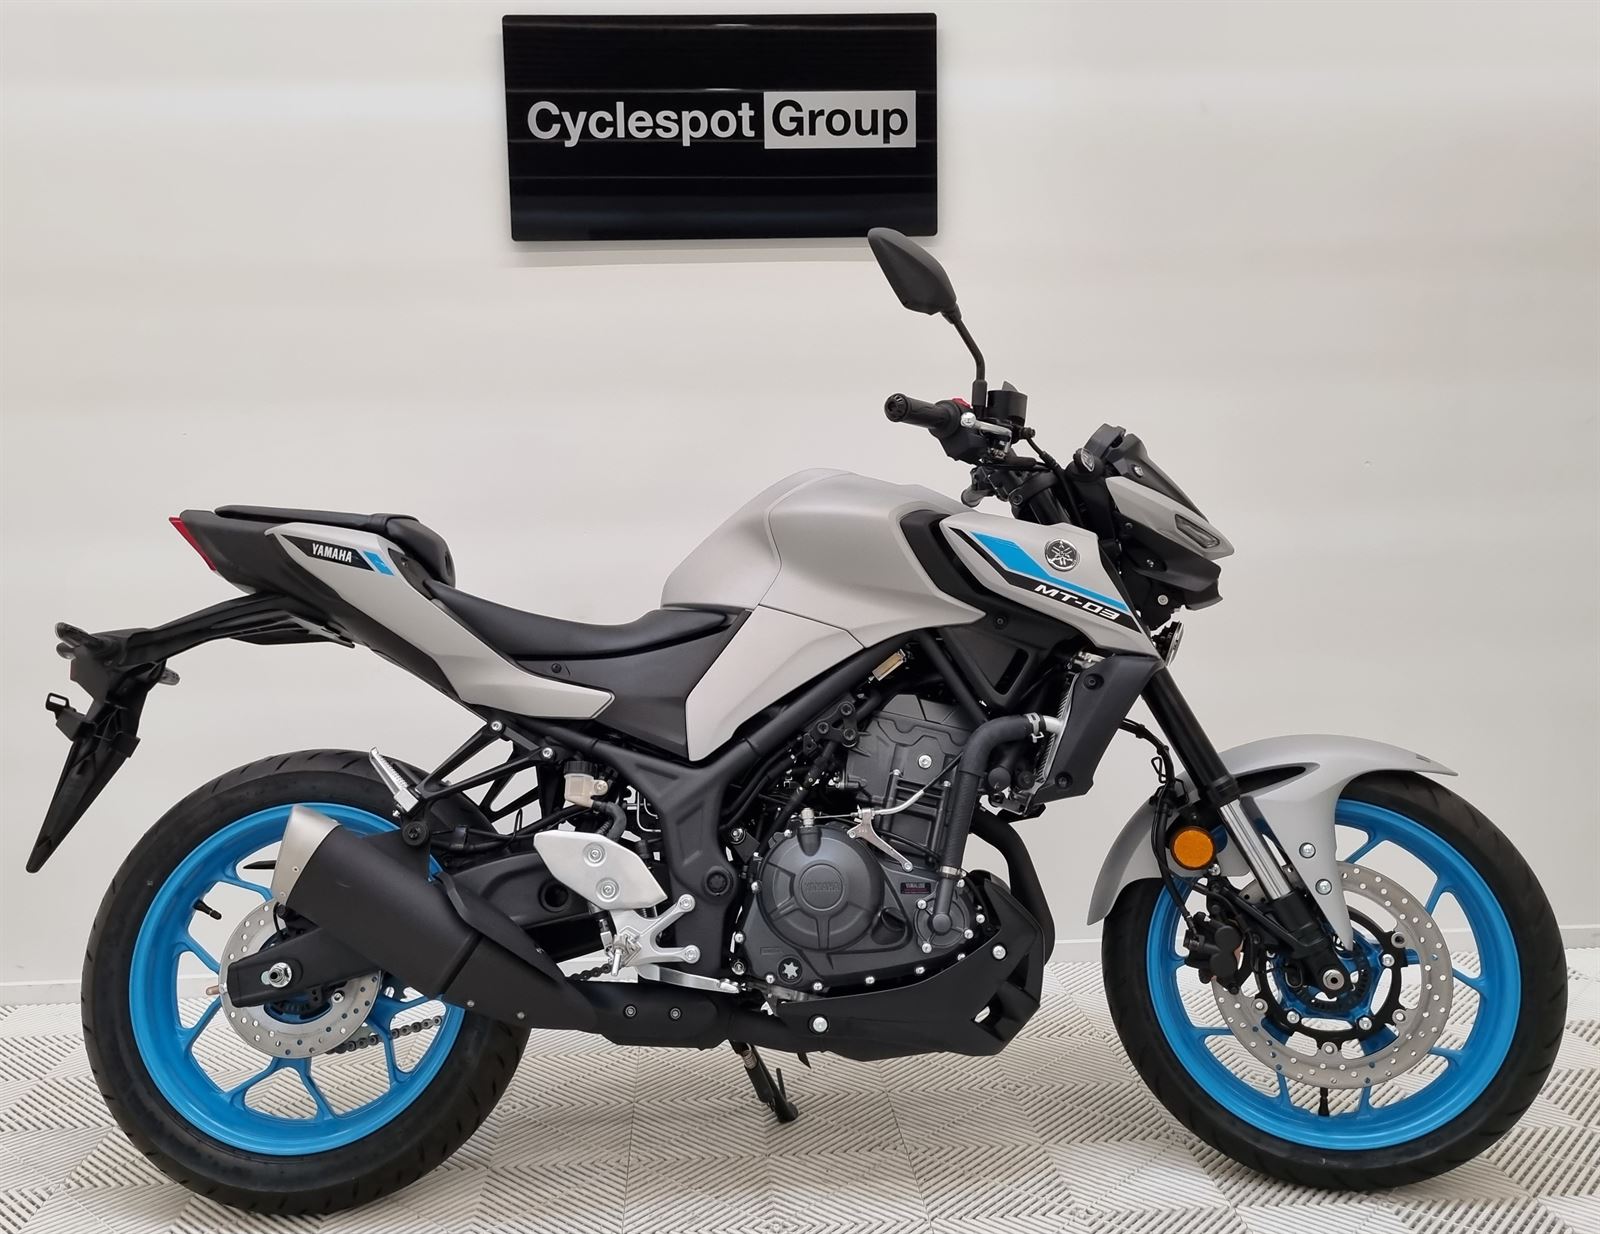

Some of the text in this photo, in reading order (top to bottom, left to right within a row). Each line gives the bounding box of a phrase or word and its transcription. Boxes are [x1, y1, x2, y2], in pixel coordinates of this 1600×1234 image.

[527, 99, 909, 147] Cyclespot Group
[312, 543, 352, 563] YAMAHA
[1034, 584, 1121, 620] MT-03
